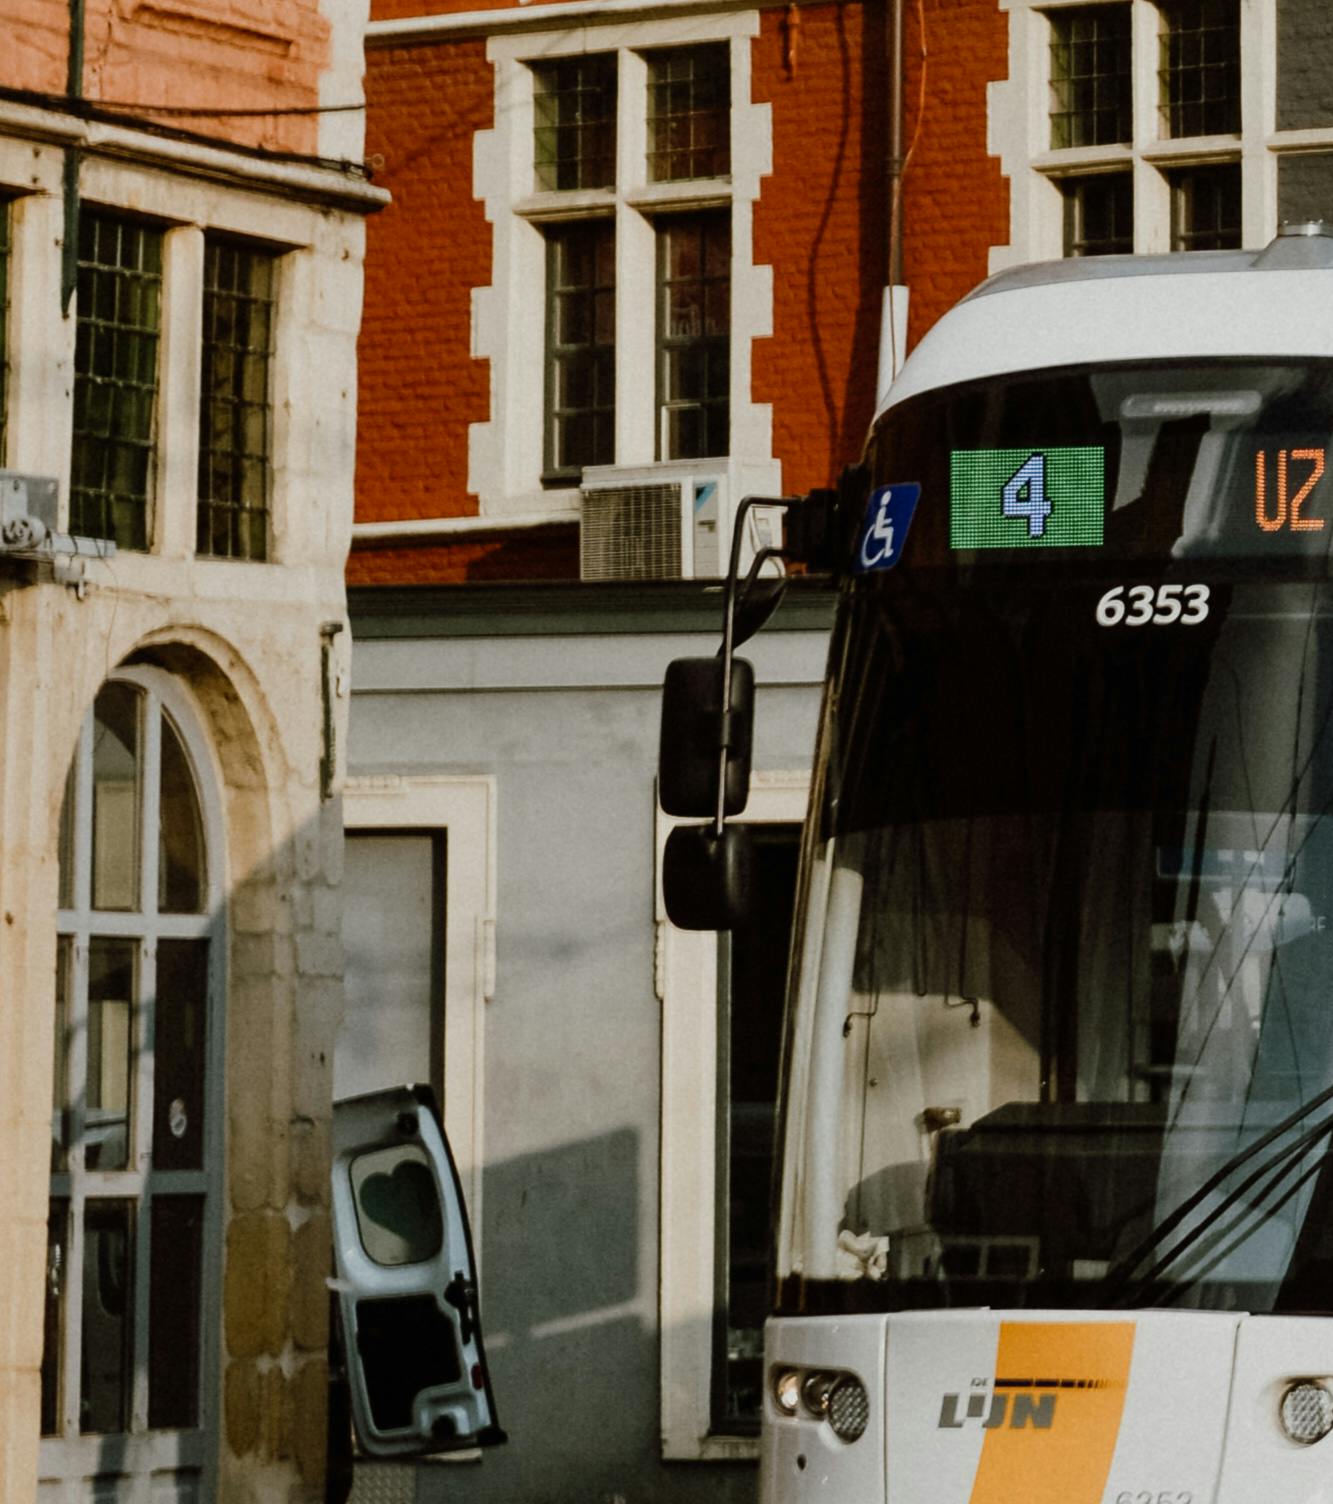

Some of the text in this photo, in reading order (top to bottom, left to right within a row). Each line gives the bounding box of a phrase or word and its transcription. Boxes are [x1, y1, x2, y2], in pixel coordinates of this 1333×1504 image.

[1002, 451, 1052, 538] 4
[1255, 448, 1325, 532] UZ
[1095, 583, 1211, 627] 6353
[938, 1393, 1057, 1429] LIJN
